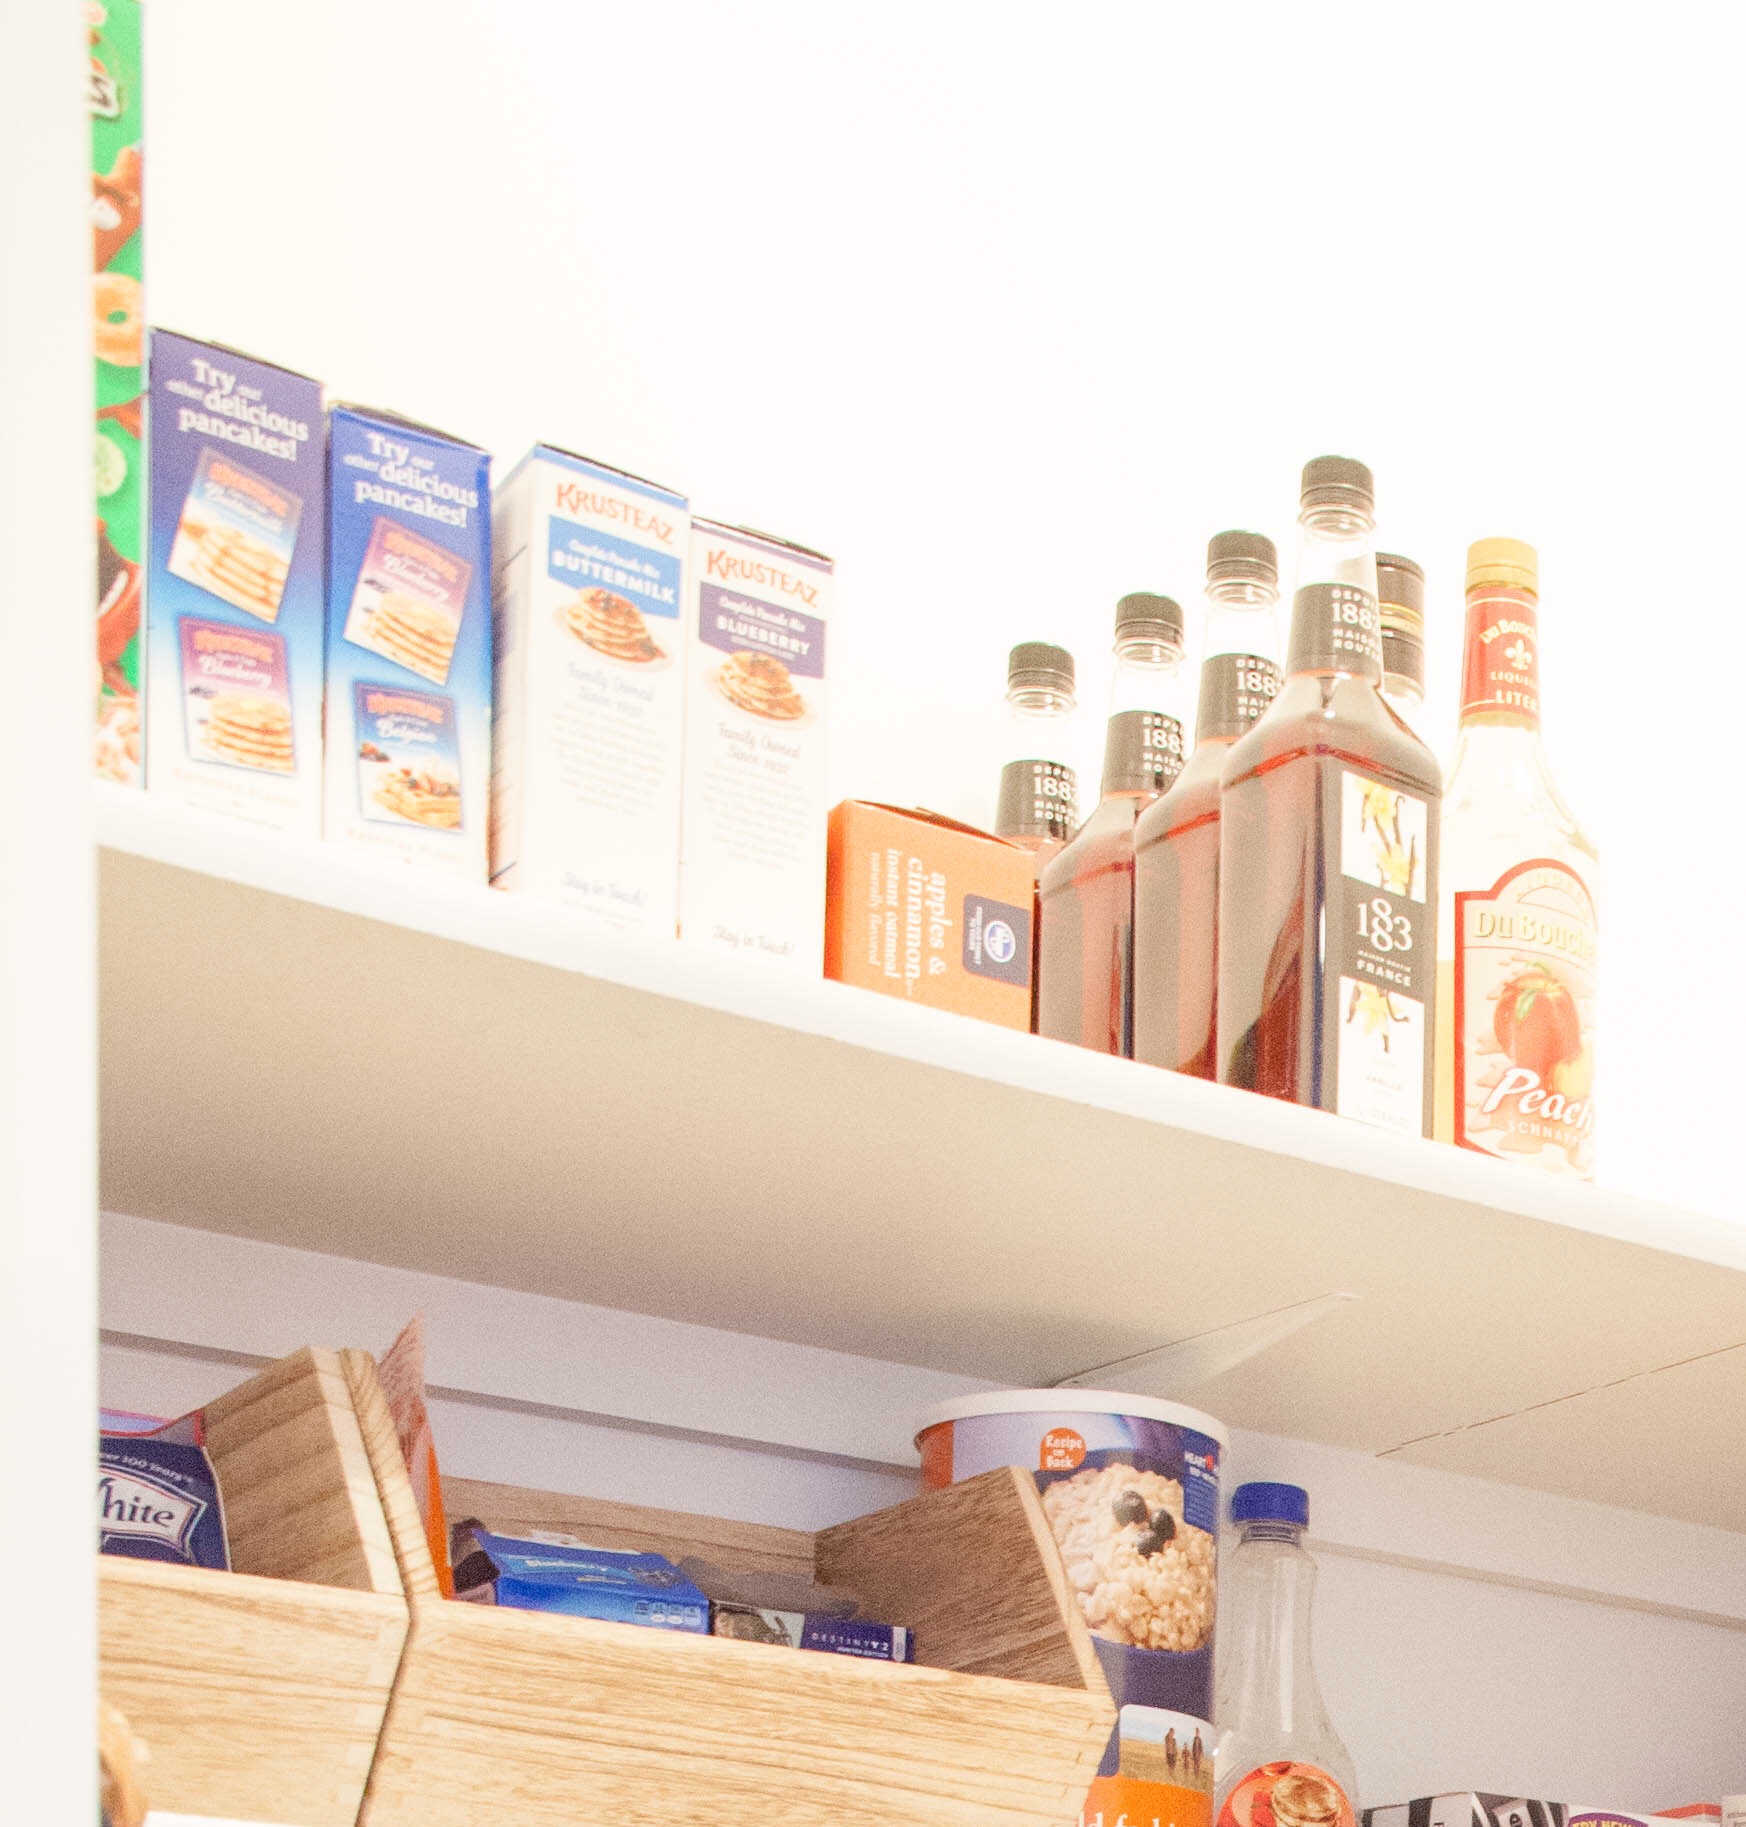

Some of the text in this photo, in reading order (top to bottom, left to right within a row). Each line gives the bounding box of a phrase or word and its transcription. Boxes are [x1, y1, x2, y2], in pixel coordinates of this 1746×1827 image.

[191, 358, 236, 394] Try
[178, 408, 297, 461] pancakes!
[203, 391, 309, 441] delicious
[367, 431, 410, 466] Try
[354, 480, 468, 528] pancakes!
[379, 462, 479, 508] delicious
[555, 481, 674, 544] KRUSTEAZ
[552, 550, 675, 604] BUTTERMILK
[706, 549, 819, 608] KRUSTEAZ
[717, 615, 810, 656] BLUEBERRY
[905, 857, 928, 980] cinnamon
[926, 872, 952, 976] apples &
[1357, 960, 1411, 987] FRANCE
[1483, 1068, 1594, 1130] Peach
[1045, 1435, 1082, 1449] Recipe
[99, 1477, 174, 1528] hite
